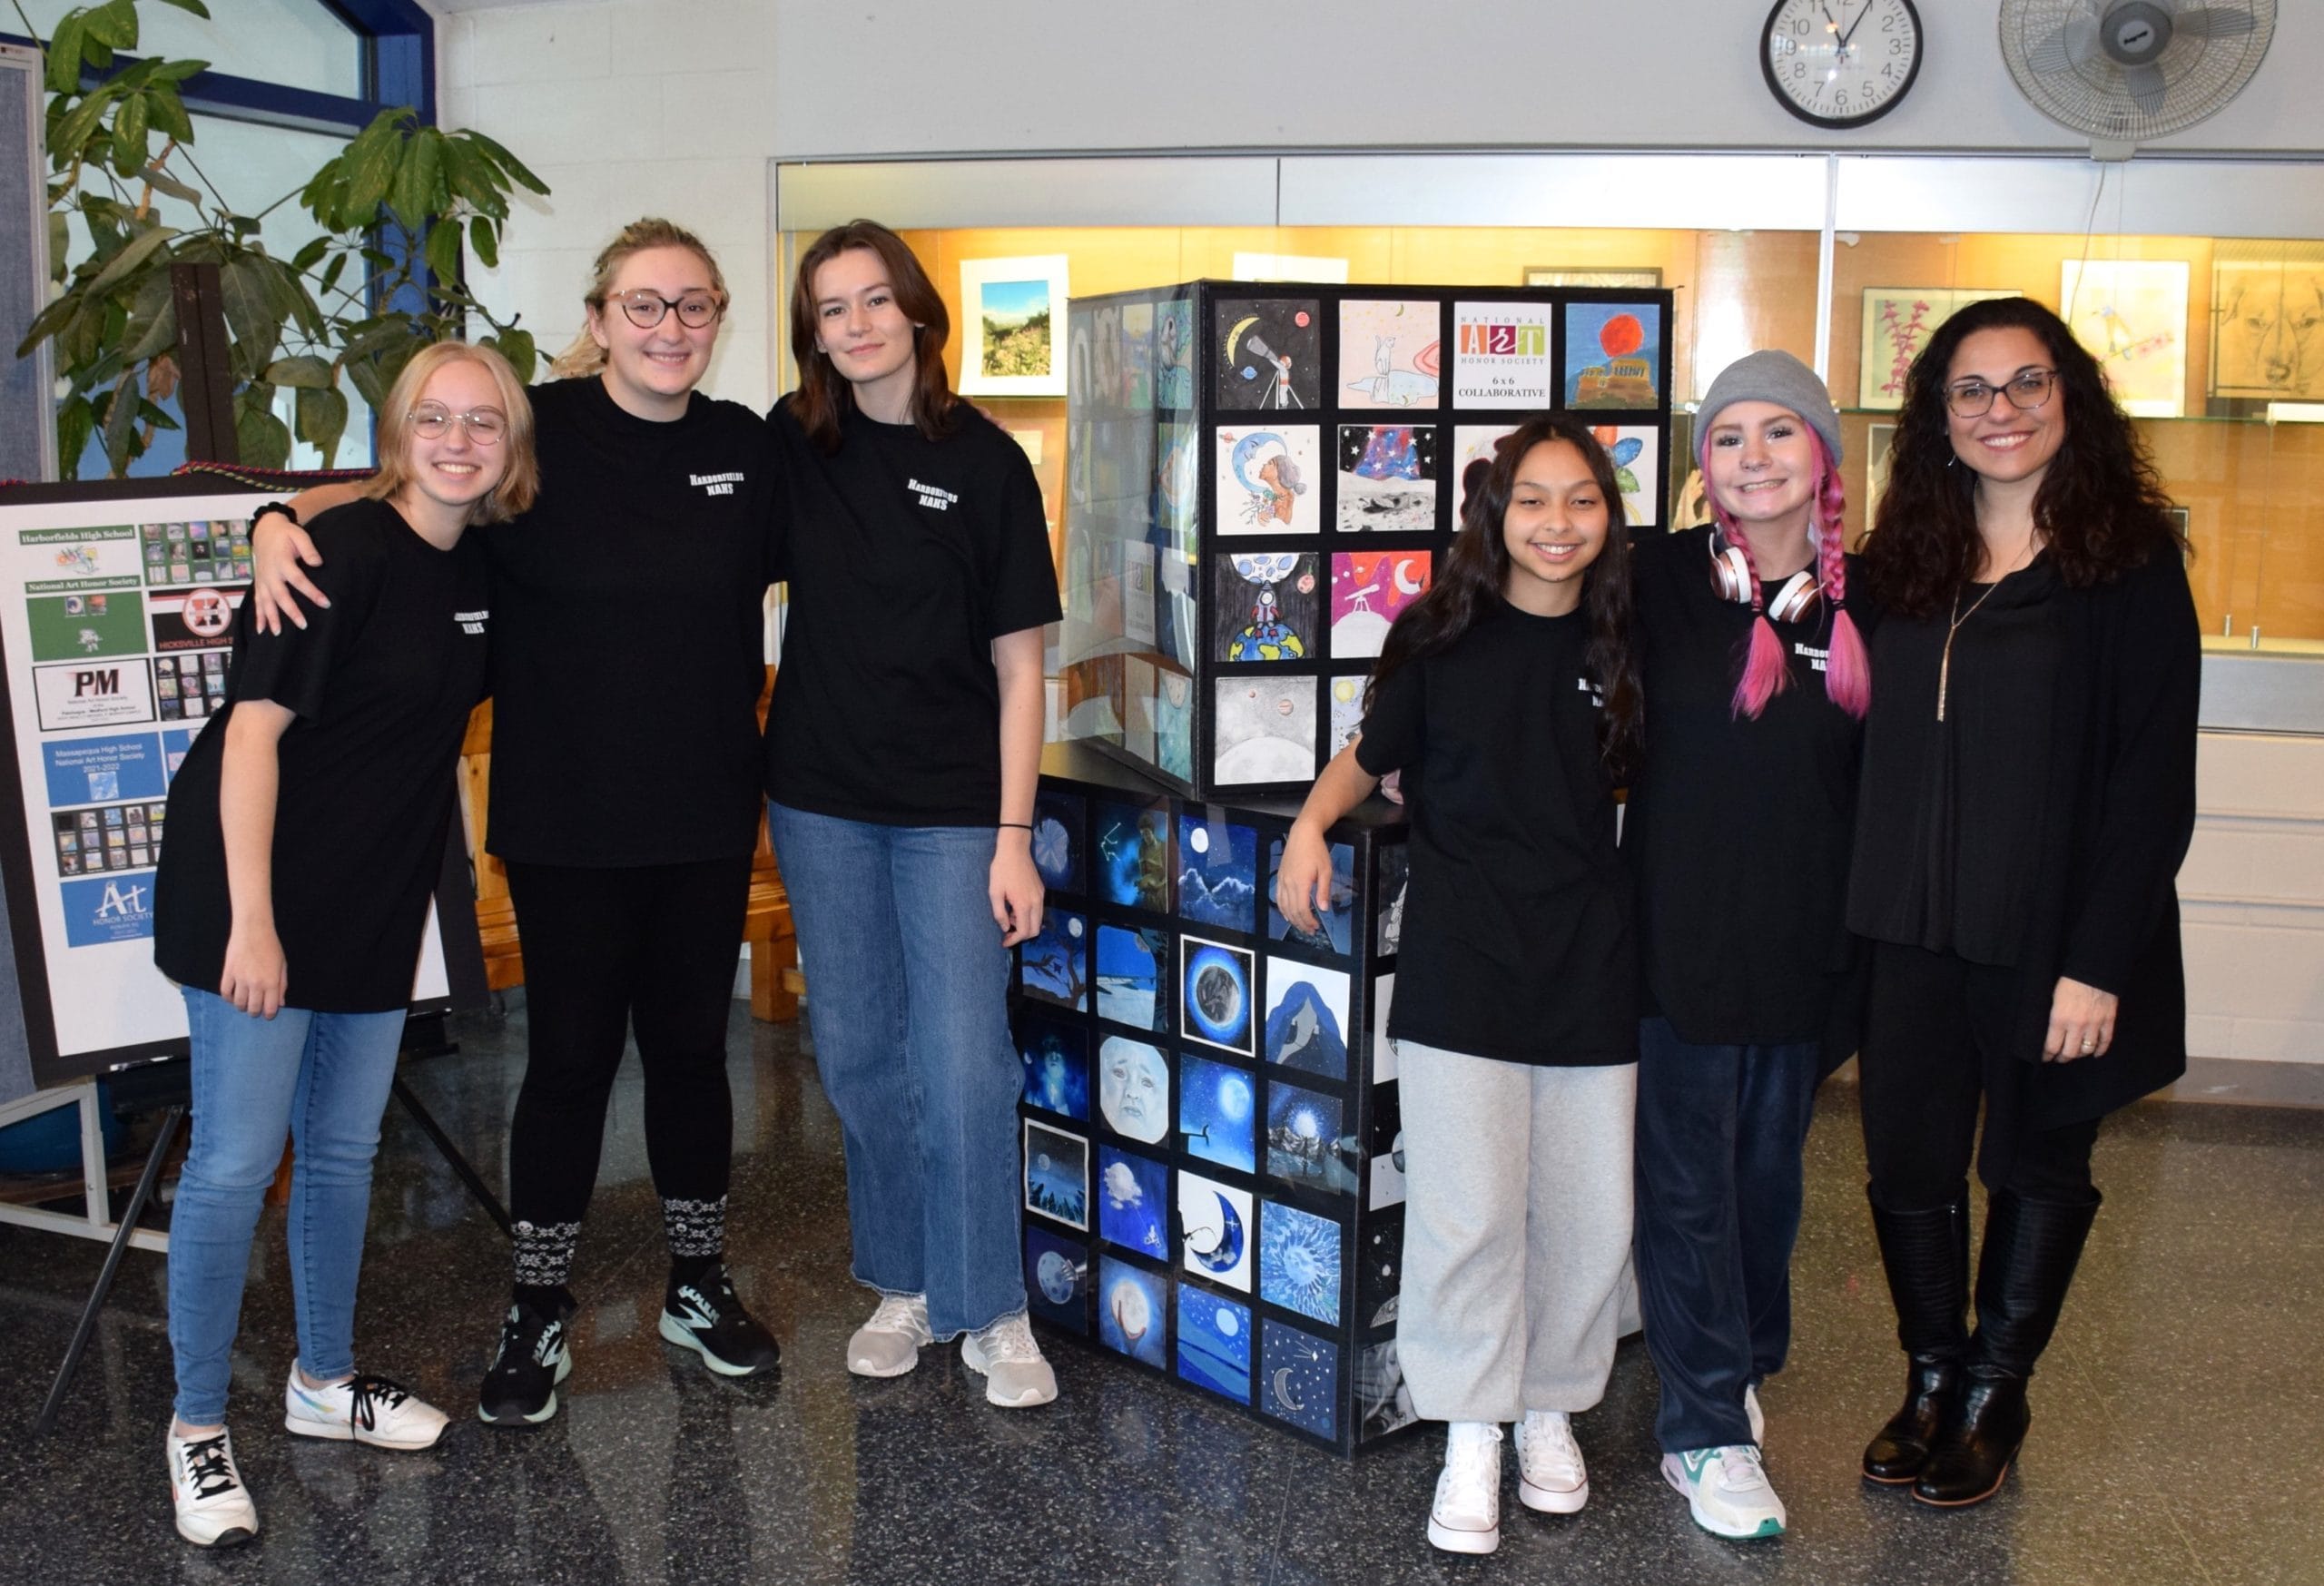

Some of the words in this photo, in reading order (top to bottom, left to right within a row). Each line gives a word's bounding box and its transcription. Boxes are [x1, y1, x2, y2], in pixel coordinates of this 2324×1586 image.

[1792, 19, 1810, 35] 10
[1882, 15, 1894, 33] 2
[1786, 39, 1797, 56] 9
[1889, 38, 1902, 55] 3
[1794, 63, 1807, 79] 8
[1881, 63, 1893, 77] 4
[1814, 82, 1826, 97] 7
[1835, 89, 1848, 105] 6
[1862, 81, 1875, 98] 5
[1461, 316, 1545, 324] NATIONAL
[1492, 377, 1499, 385] 6
[1508, 377, 1515, 385] 6
[1458, 389, 1546, 398] COLLABORATIVE
[22, 533, 79, 543] Harborfields
[80, 531, 103, 541] High
[103, 529, 133, 538] School
[28, 582, 64, 592] National
[65, 581, 79, 589] Art
[80, 579, 107, 587] Honor
[108, 577, 137, 586] Society
[74, 668, 120, 696] PM
